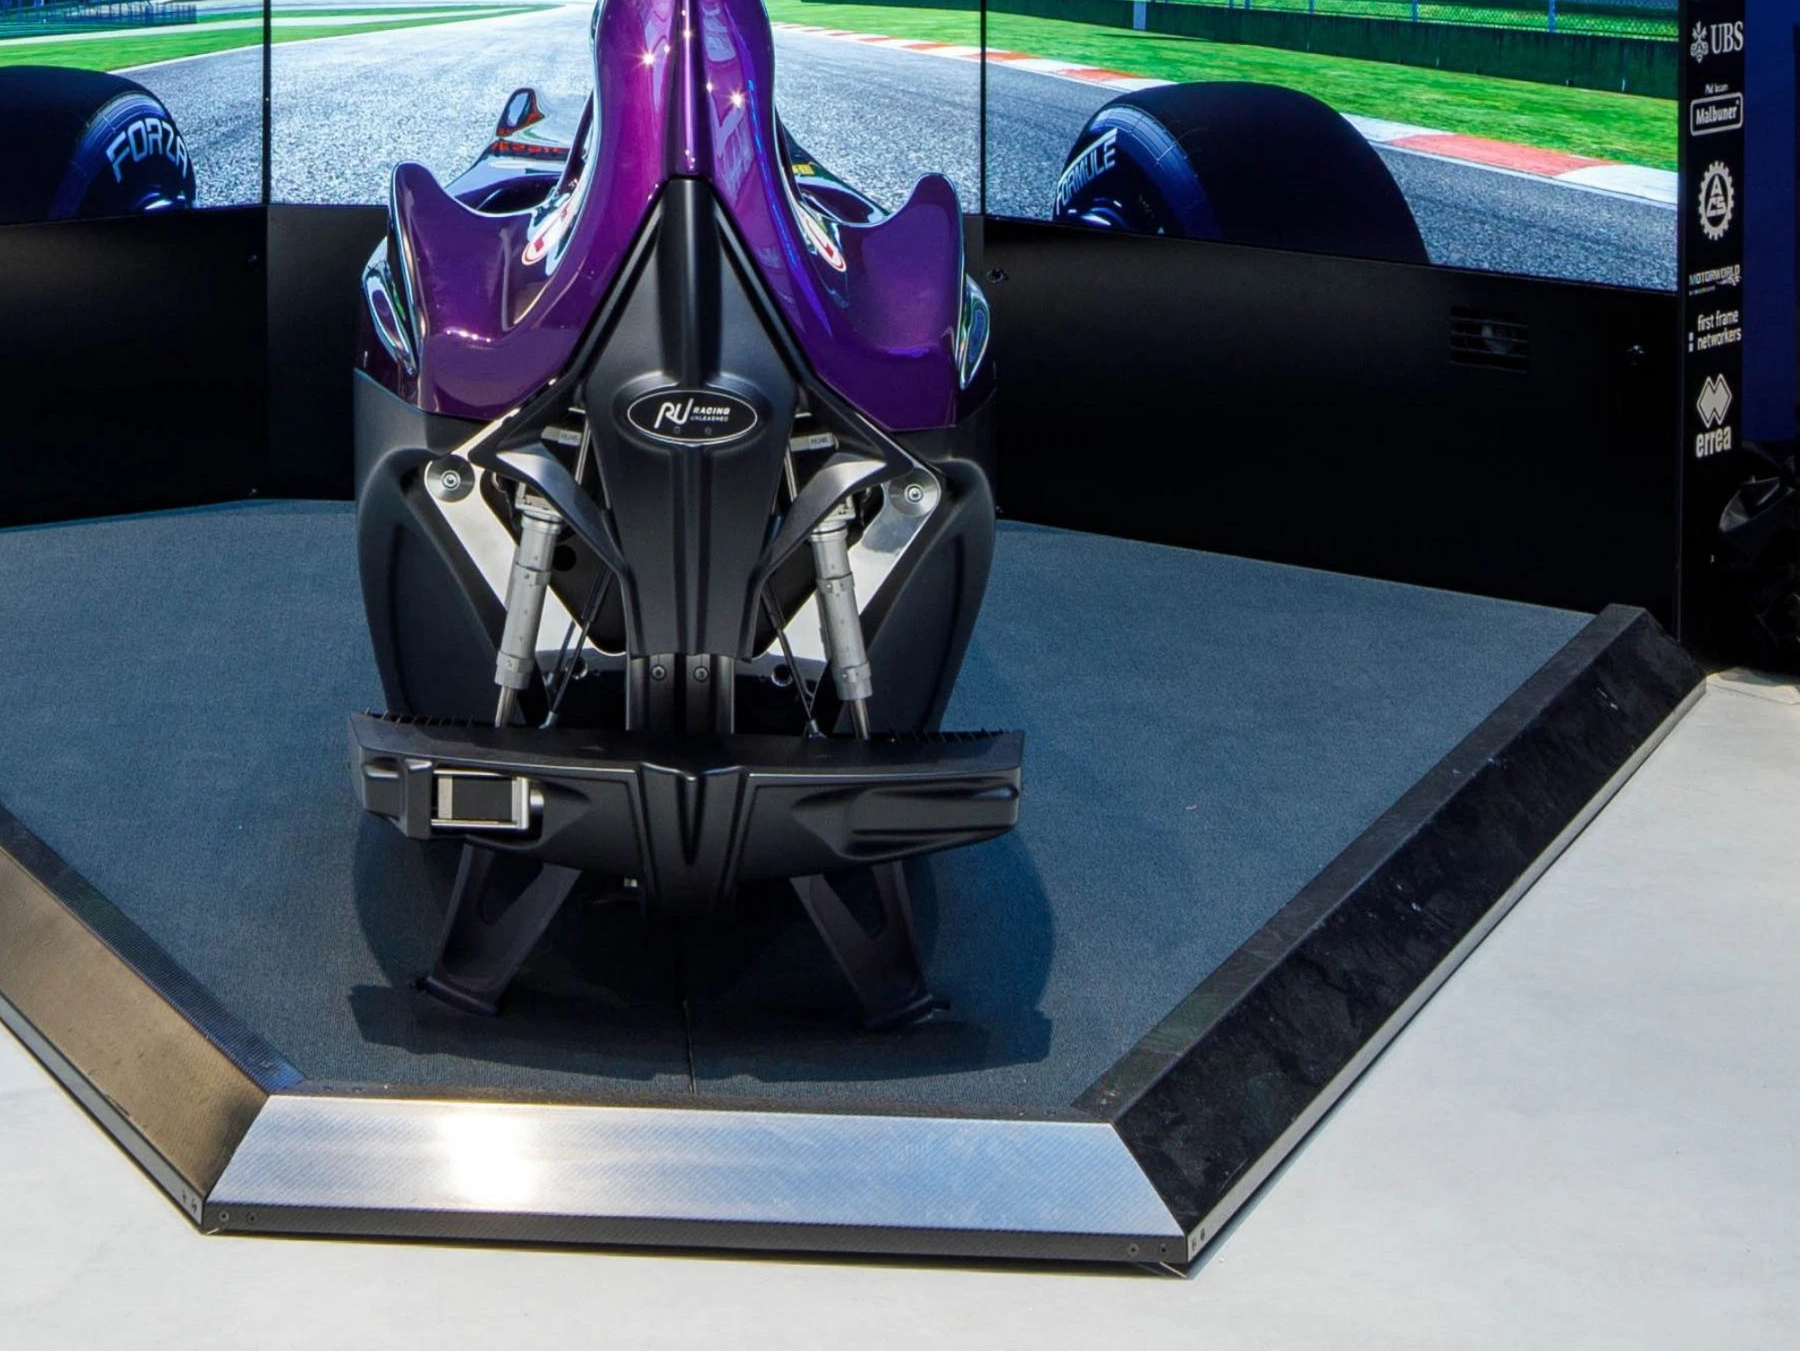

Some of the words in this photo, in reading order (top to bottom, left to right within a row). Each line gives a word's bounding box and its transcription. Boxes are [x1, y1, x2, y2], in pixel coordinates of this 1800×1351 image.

[1711, 21, 1744, 54] UBS
[106, 117, 188, 183] FORZA
[1698, 314, 1714, 331] first
[1716, 310, 1739, 327] frame
[1697, 327, 1741, 350] networkers
[692, 407, 731, 415] RACING
[1695, 426, 1732, 458] errea
